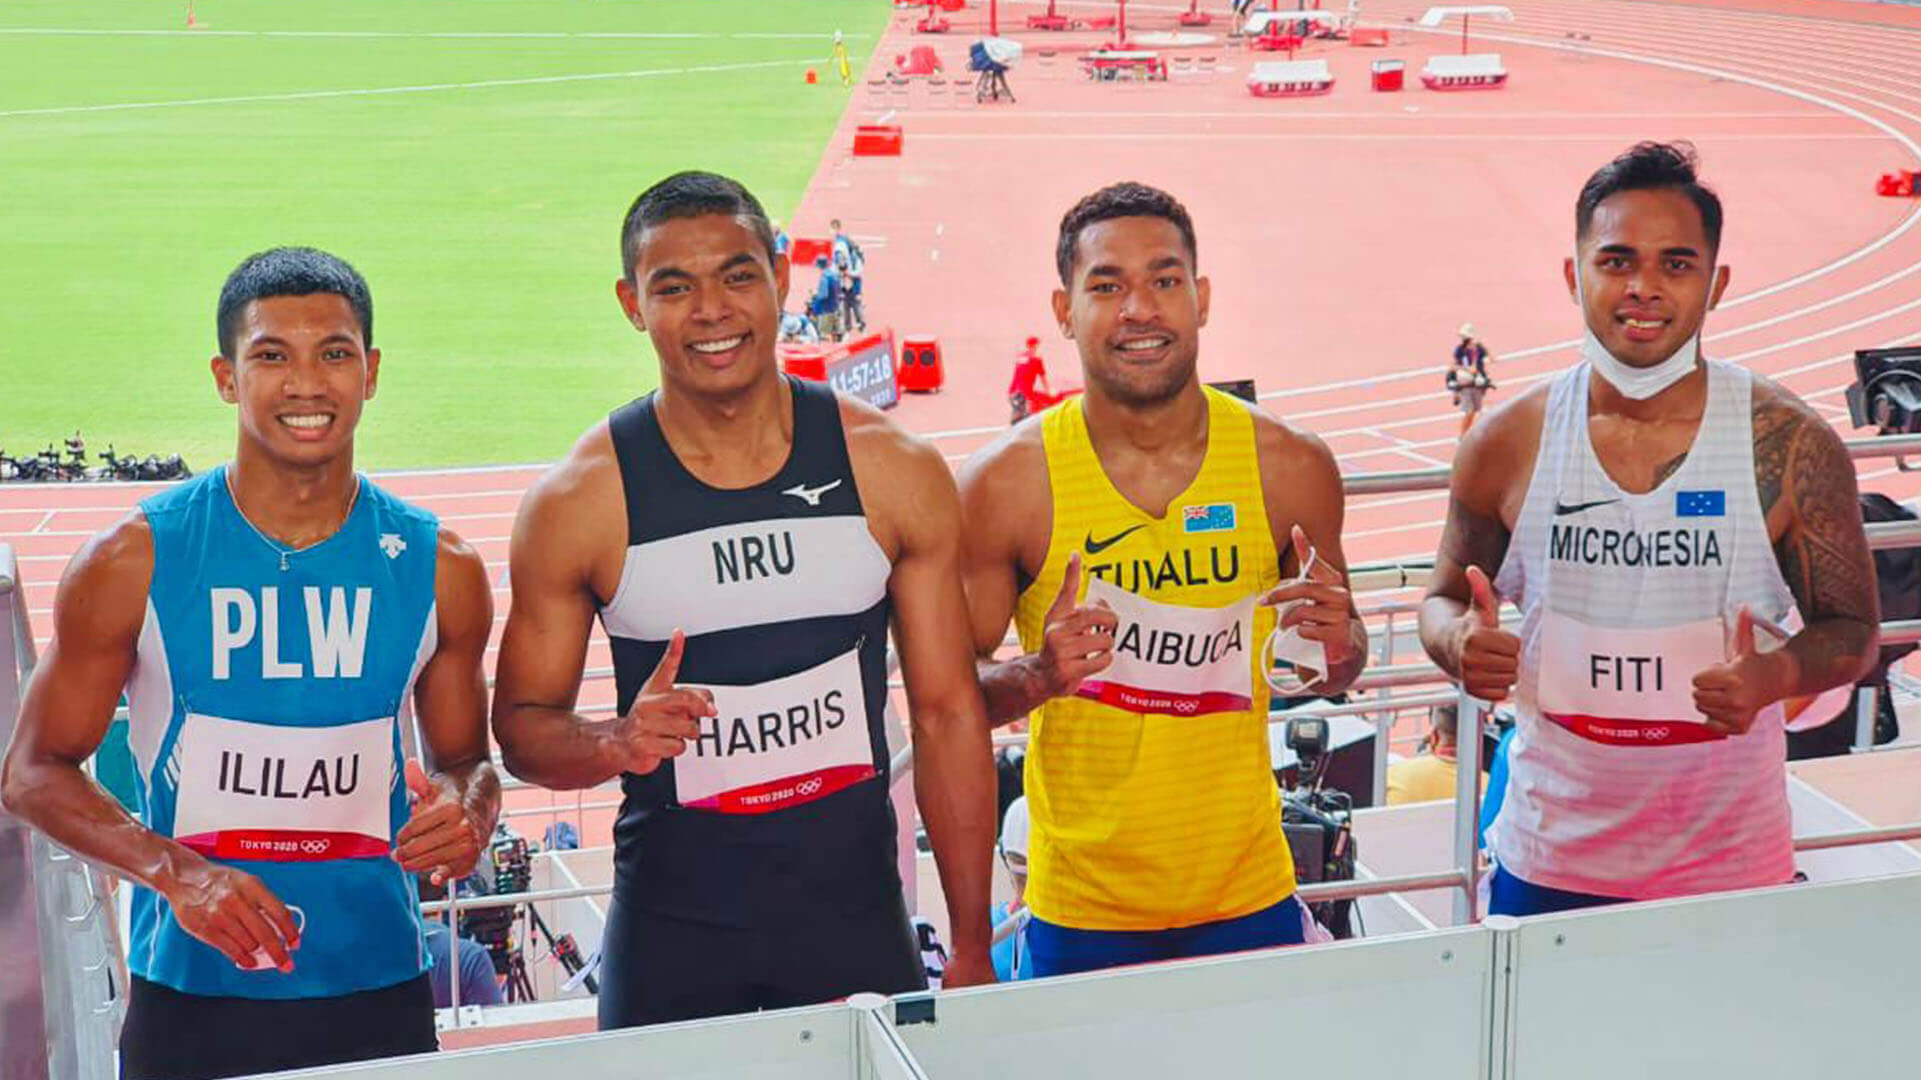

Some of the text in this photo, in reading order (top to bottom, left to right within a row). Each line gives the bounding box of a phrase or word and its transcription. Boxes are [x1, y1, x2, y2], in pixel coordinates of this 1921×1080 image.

[712, 531, 795, 585] NRU
[1550, 524, 1722, 567] MICRONESIA
[210, 586, 373, 680] PLW
[1112, 620, 1243, 667] AIBUCA
[1590, 654, 1663, 693] FITI
[696, 690, 846, 758] HARRIS
[218, 751, 360, 799] ILILAU
[740, 787, 795, 806] TOKYO 2020
[239, 839, 299, 852] TOKYO 2020
